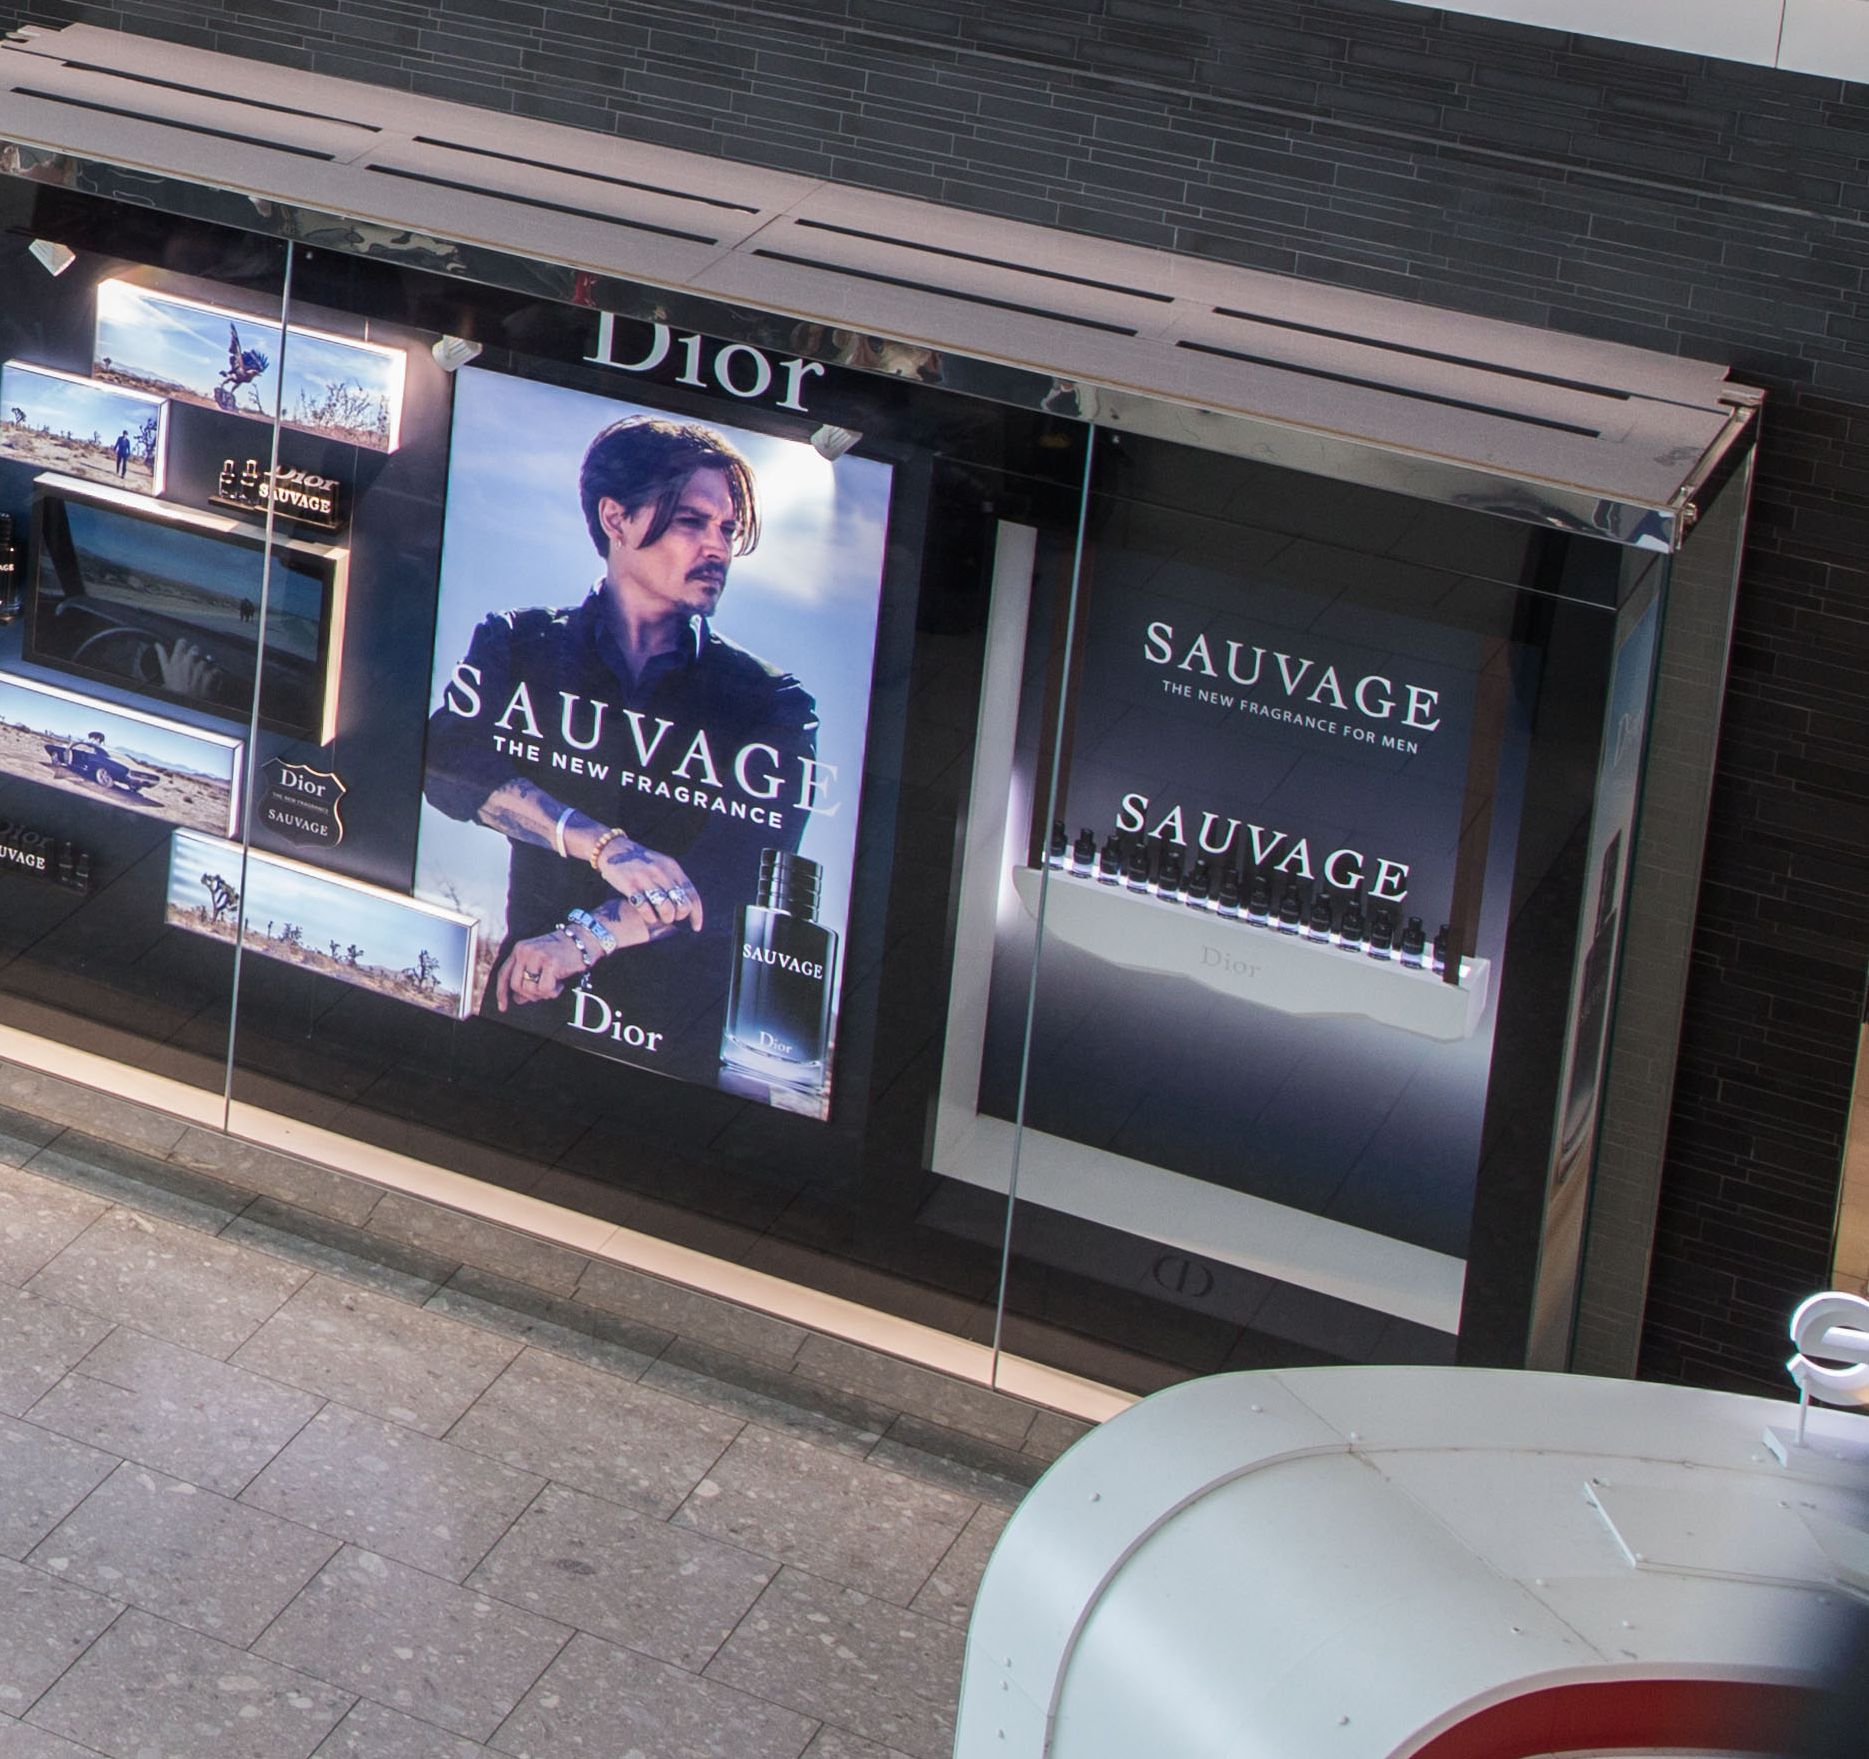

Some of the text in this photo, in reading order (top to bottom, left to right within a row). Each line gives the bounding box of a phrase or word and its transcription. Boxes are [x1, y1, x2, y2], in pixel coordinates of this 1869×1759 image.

[583, 311, 826, 412] Dior
[259, 483, 332, 515] SAUVAGE
[1144, 621, 1441, 732] SAUVAGE
[447, 663, 842, 817] SAUVAGE
[1162, 680, 1419, 755] THE NEW FRAGRANCE FOR MEN
[279, 768, 327, 797] Dior
[493, 735, 783, 830] THE NEW FRAGRANCE
[268, 808, 329, 837] SAUVAGE
[1115, 792, 1410, 903] SAUVAGE
[743, 943, 824, 981] SAUVAGE
[1200, 944, 1262, 979] Dior
[567, 986, 663, 1053] Dior
[759, 1030, 793, 1055] Dior
